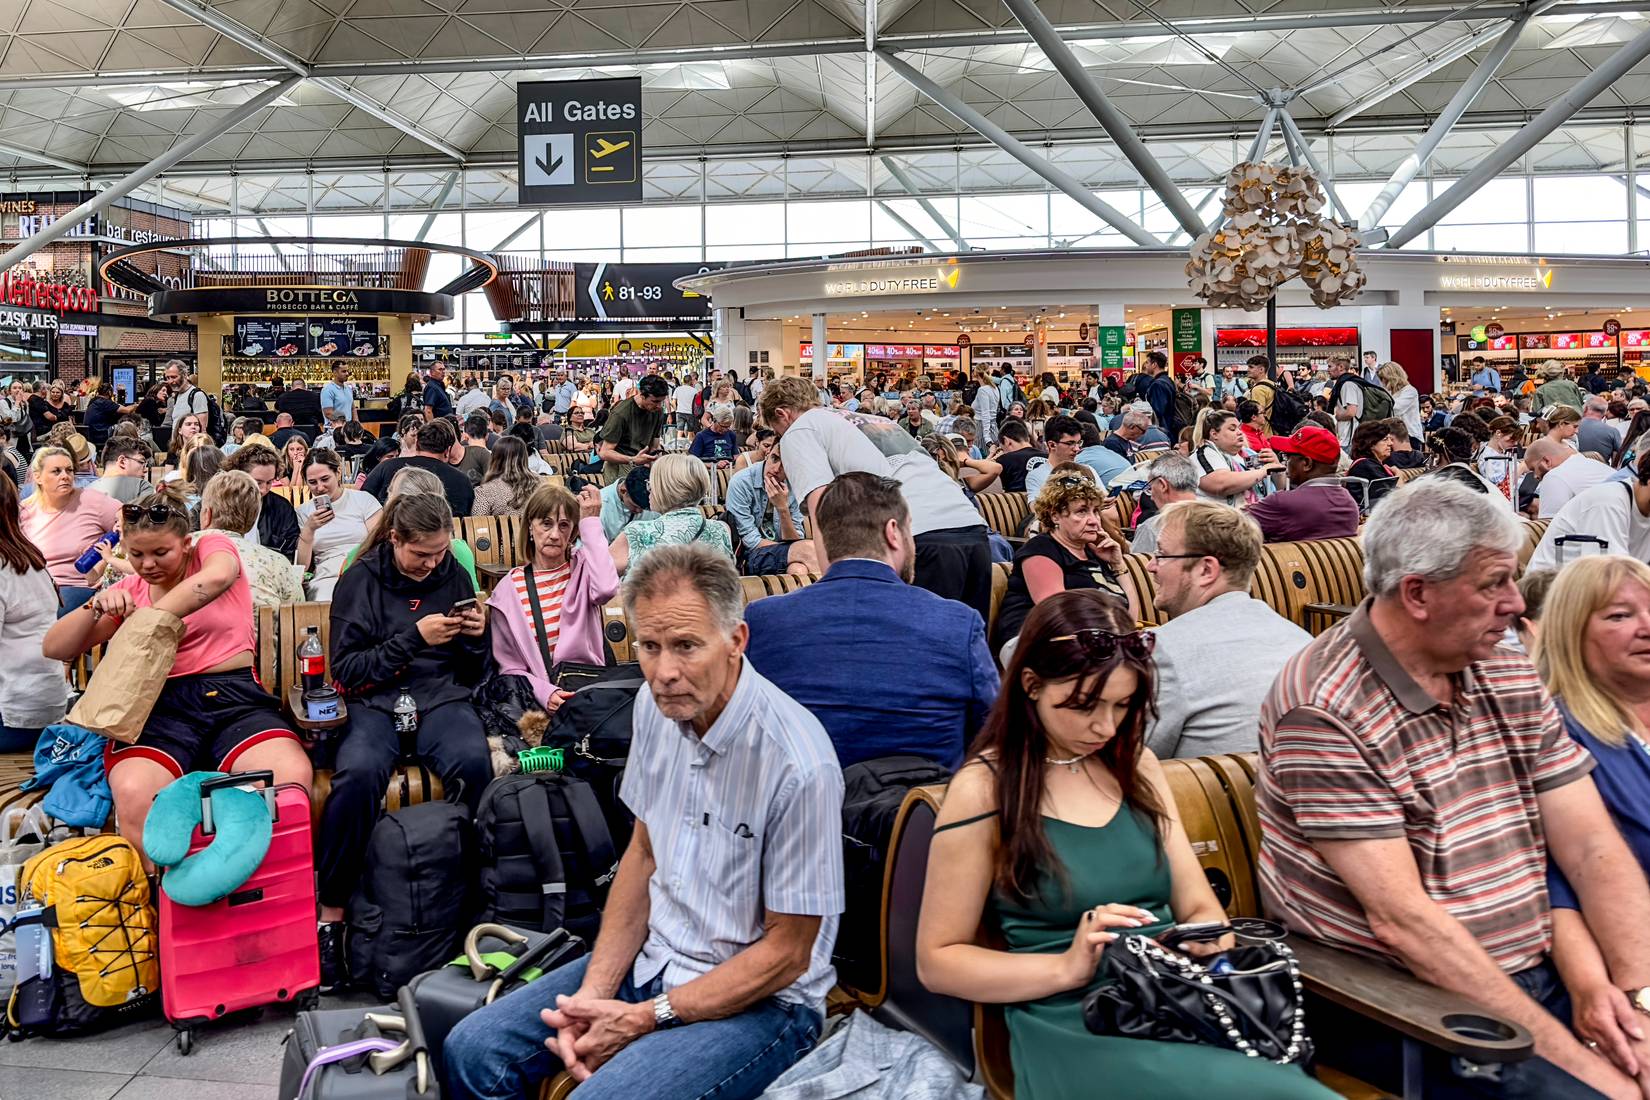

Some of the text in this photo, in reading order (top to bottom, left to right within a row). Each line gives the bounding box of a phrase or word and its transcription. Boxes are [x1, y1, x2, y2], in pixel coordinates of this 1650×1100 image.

[524, 100, 636, 122] All Gates
[106, 220, 126, 239] bar
[0, 271, 98, 318] Wetherspoon
[266, 289, 359, 303] BOTTEGA
[619, 286, 662, 300] 81-93
[0, 311, 58, 329] CASK ALES
[643, 342, 681, 352] Shuttle
